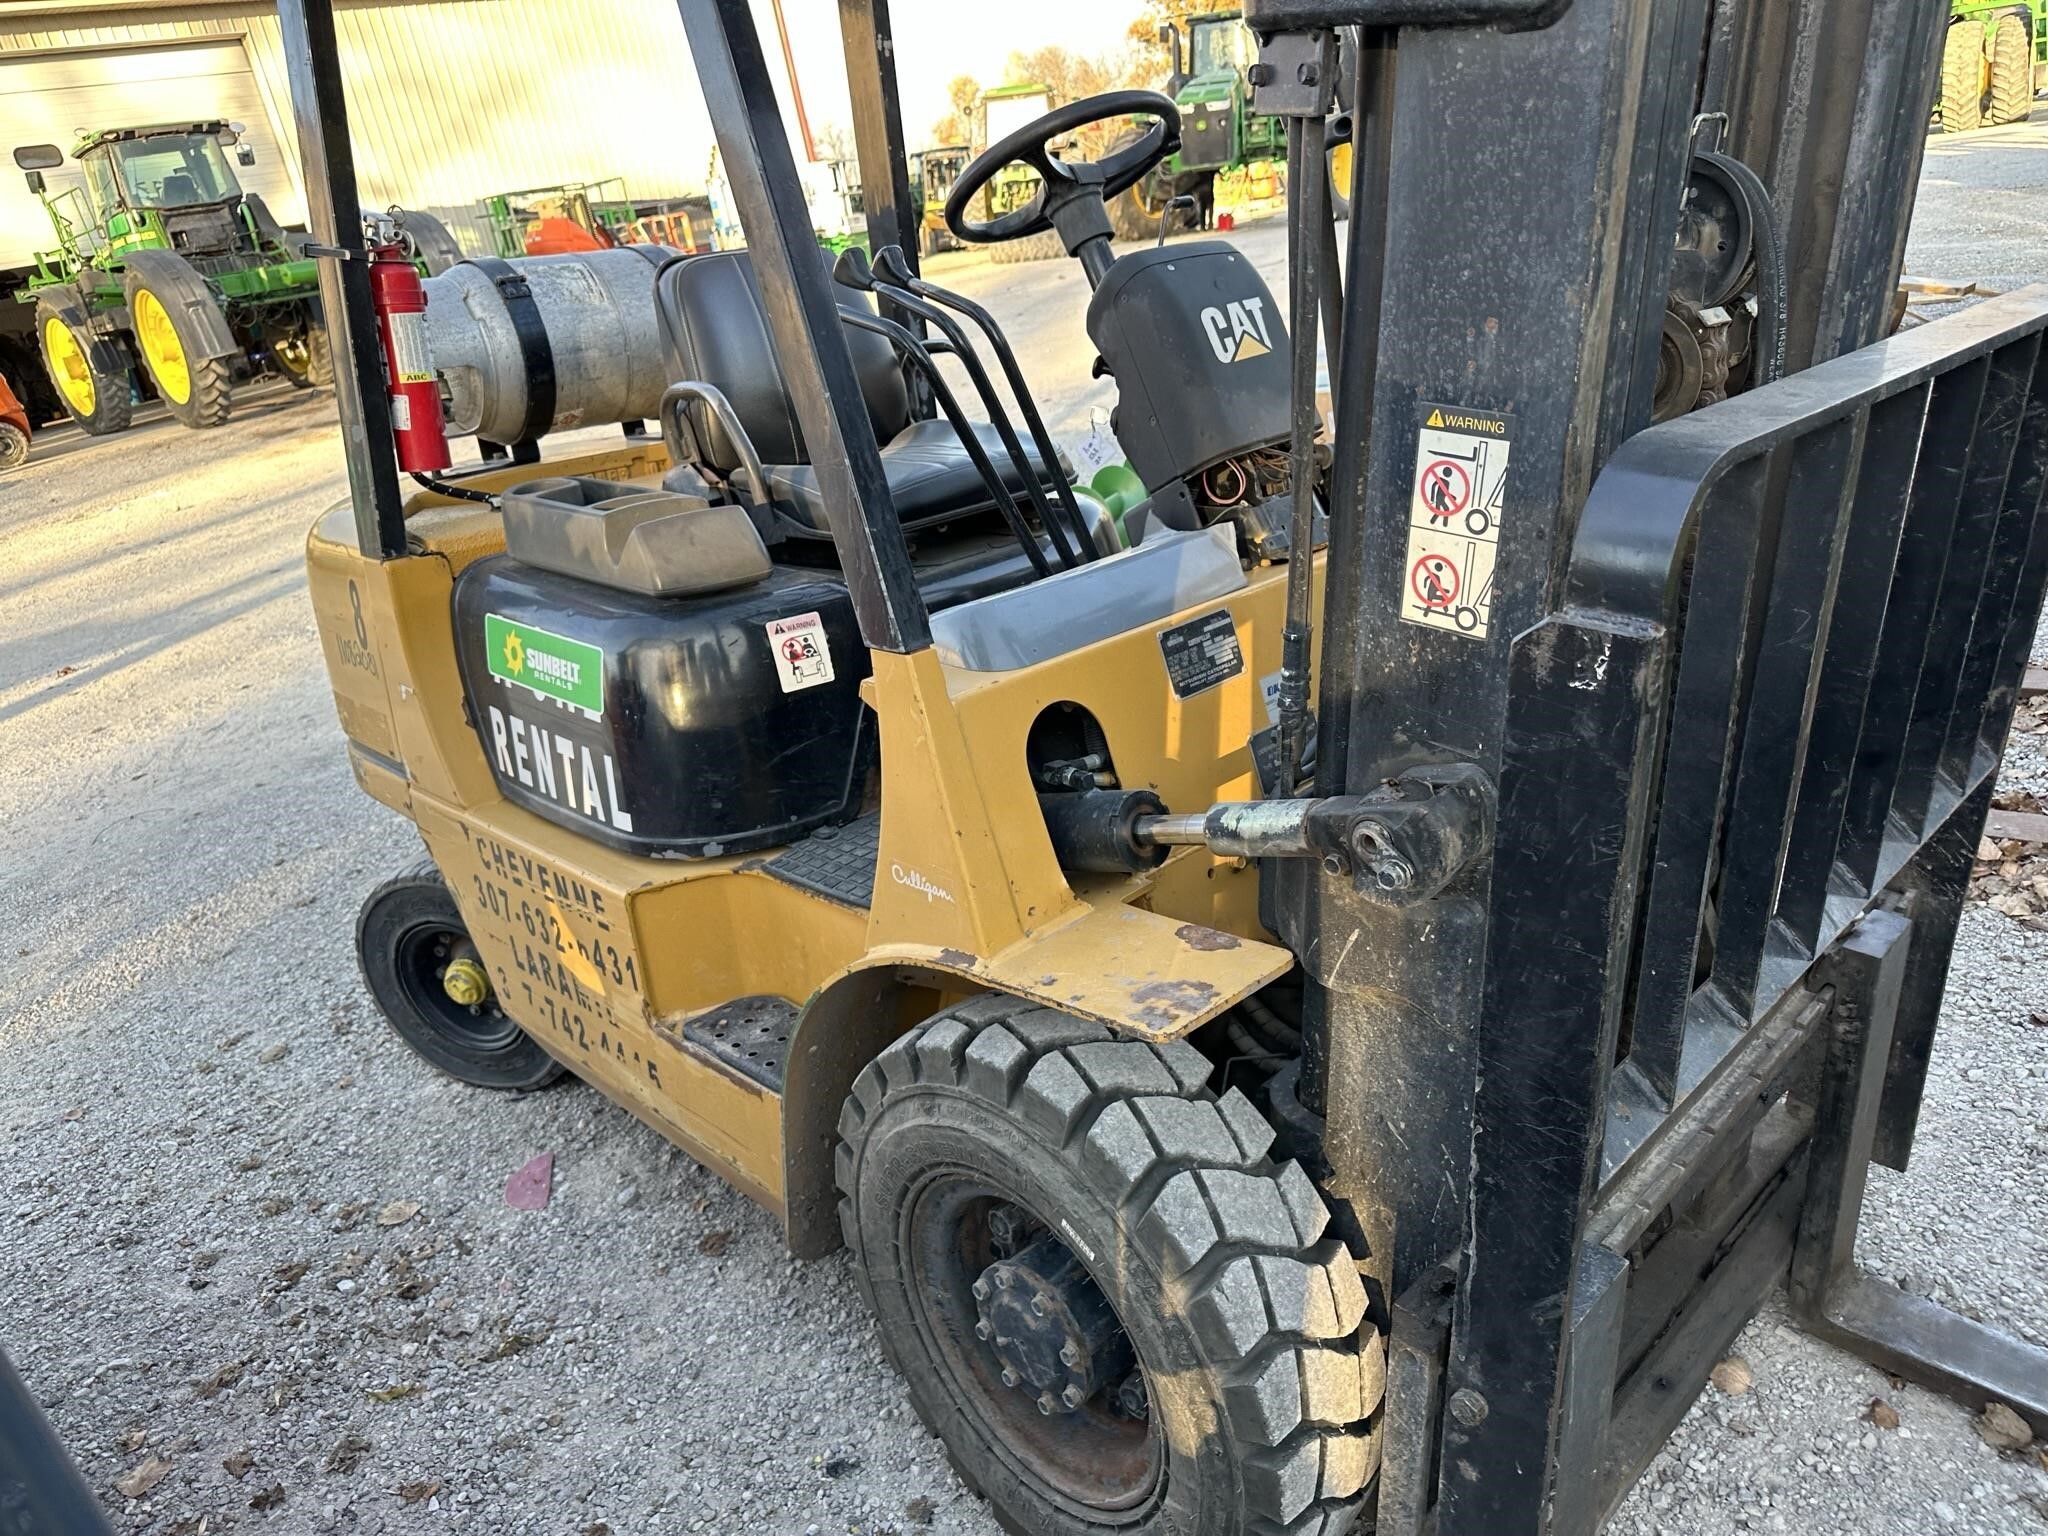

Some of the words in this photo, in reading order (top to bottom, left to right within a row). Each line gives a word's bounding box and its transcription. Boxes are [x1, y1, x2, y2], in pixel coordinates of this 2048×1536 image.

[1201, 297, 1272, 363] CAT
[406, 373, 428, 382] ABC
[1445, 414, 1505, 434] WARNING
[349, 579, 368, 650] 8
[785, 619, 816, 632] WARNING
[526, 648, 580, 684] SUNBELT
[534, 671, 574, 690] RENTALS
[489, 705, 633, 833] RENTAL
[892, 864, 953, 903] Culligan
